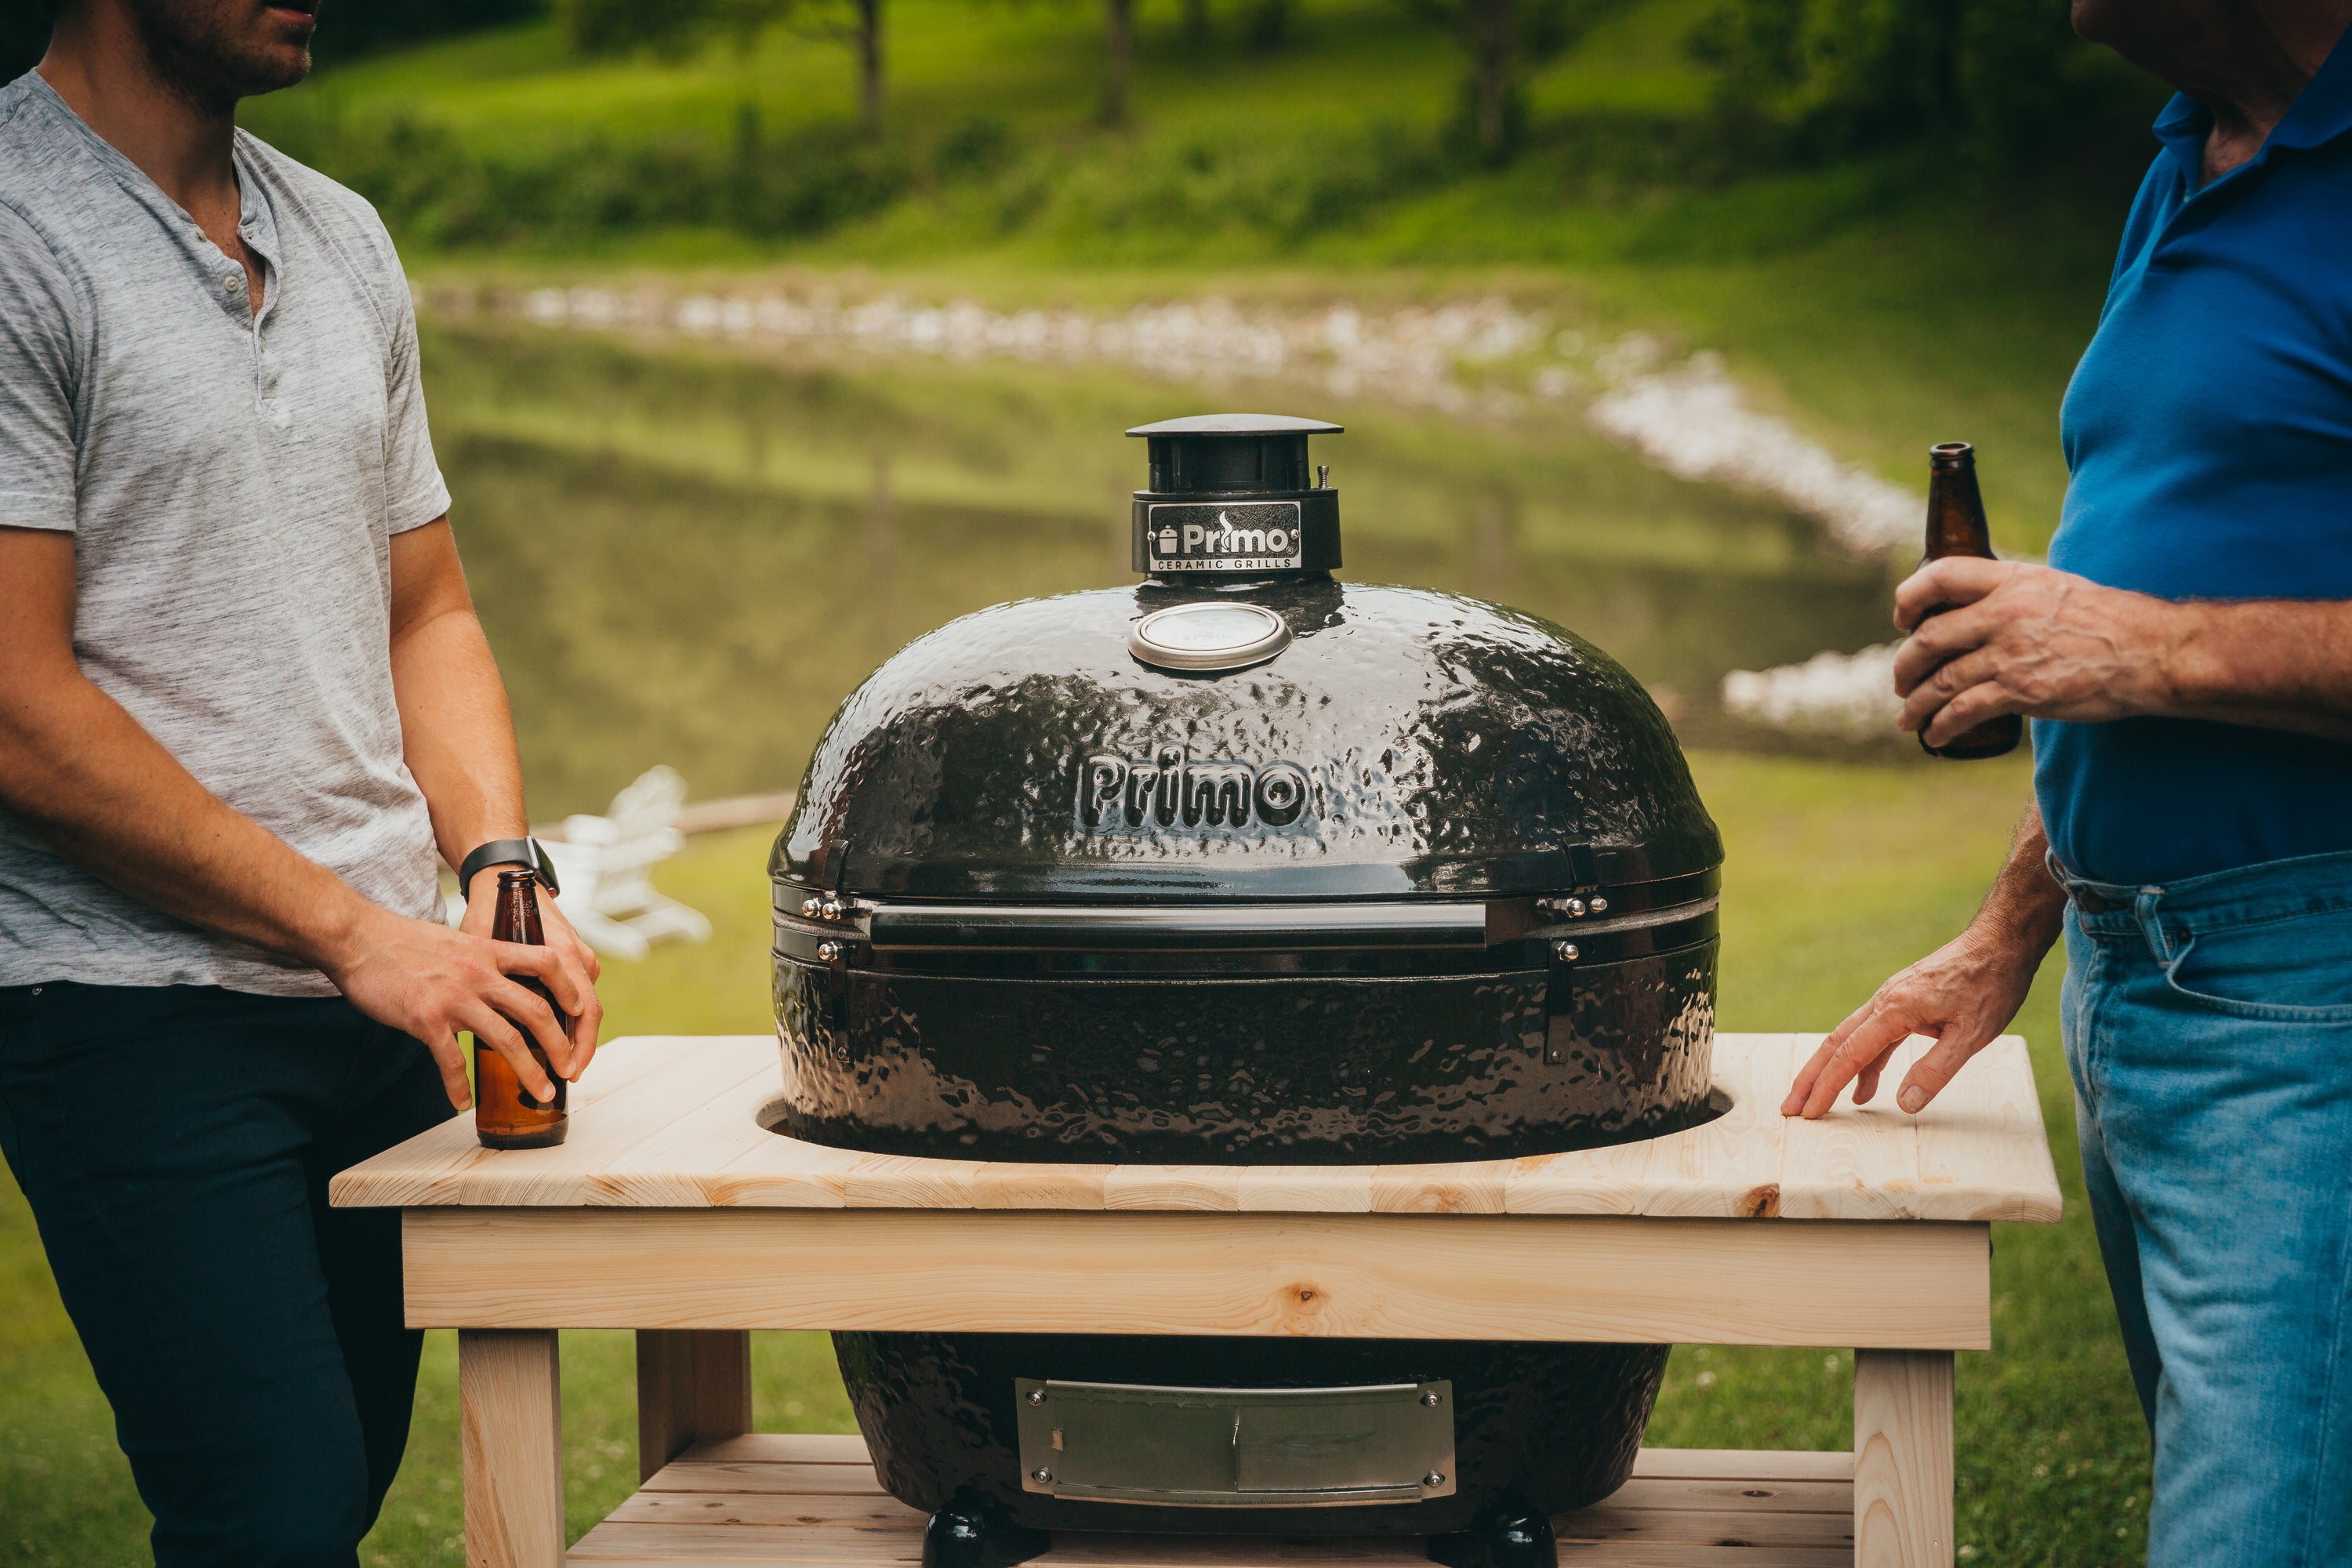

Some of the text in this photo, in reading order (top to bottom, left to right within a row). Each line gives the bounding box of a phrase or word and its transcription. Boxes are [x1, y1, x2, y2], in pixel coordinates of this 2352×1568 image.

[1182, 511, 1290, 554] Primo
[1158, 558, 1291, 570] CERAMIC GRILLS
[1077, 742, 1310, 829] Primo
